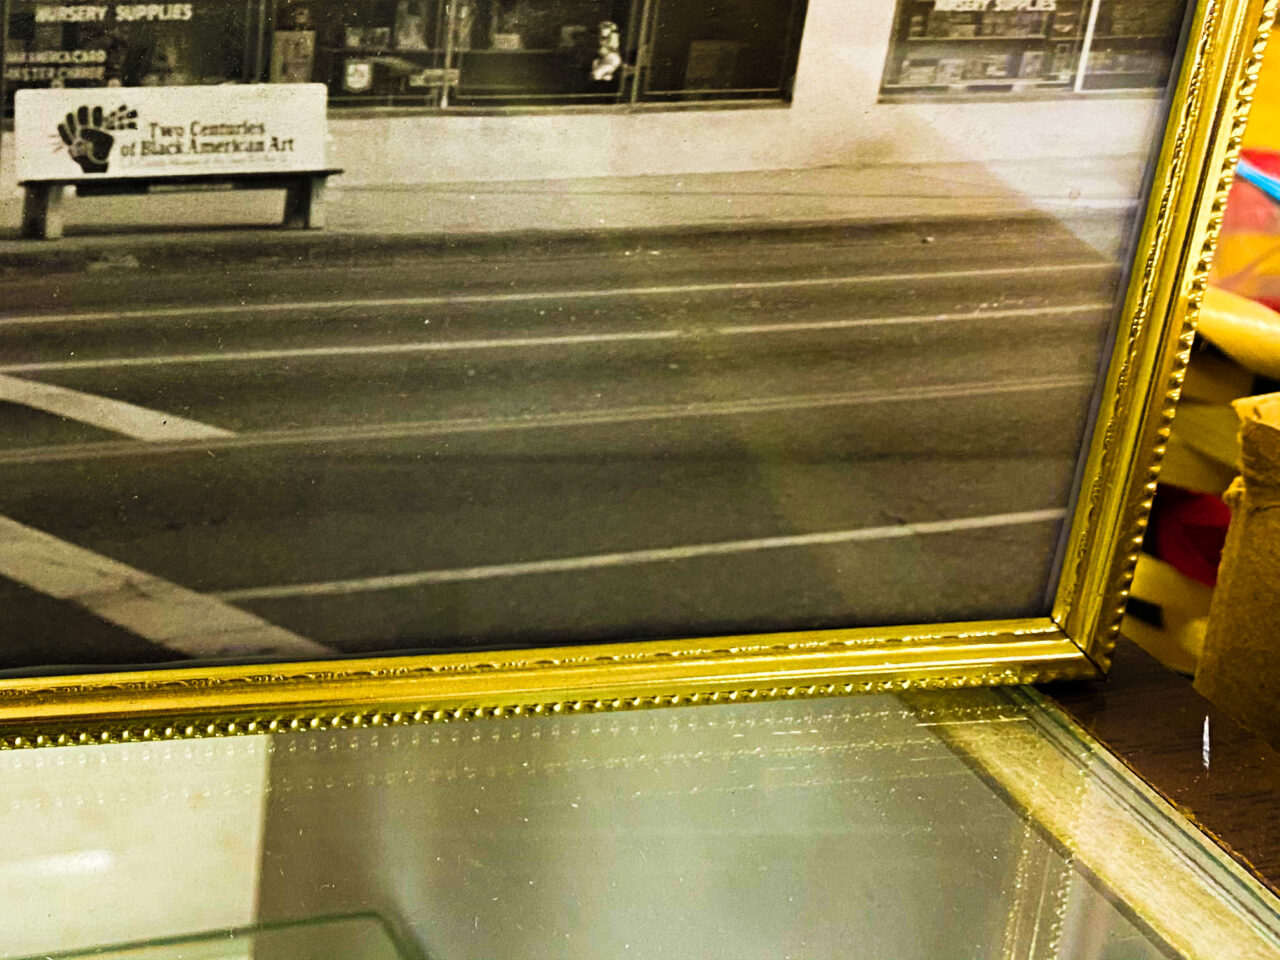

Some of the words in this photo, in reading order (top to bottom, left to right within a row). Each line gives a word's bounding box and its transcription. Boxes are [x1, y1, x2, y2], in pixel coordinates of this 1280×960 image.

[150, 122, 184, 137] Two
[190, 120, 266, 137] Centuries
[120, 142, 135, 157] of
[141, 139, 183, 156] Black
[189, 137, 265, 154] American
[270, 136, 294, 152] Art
